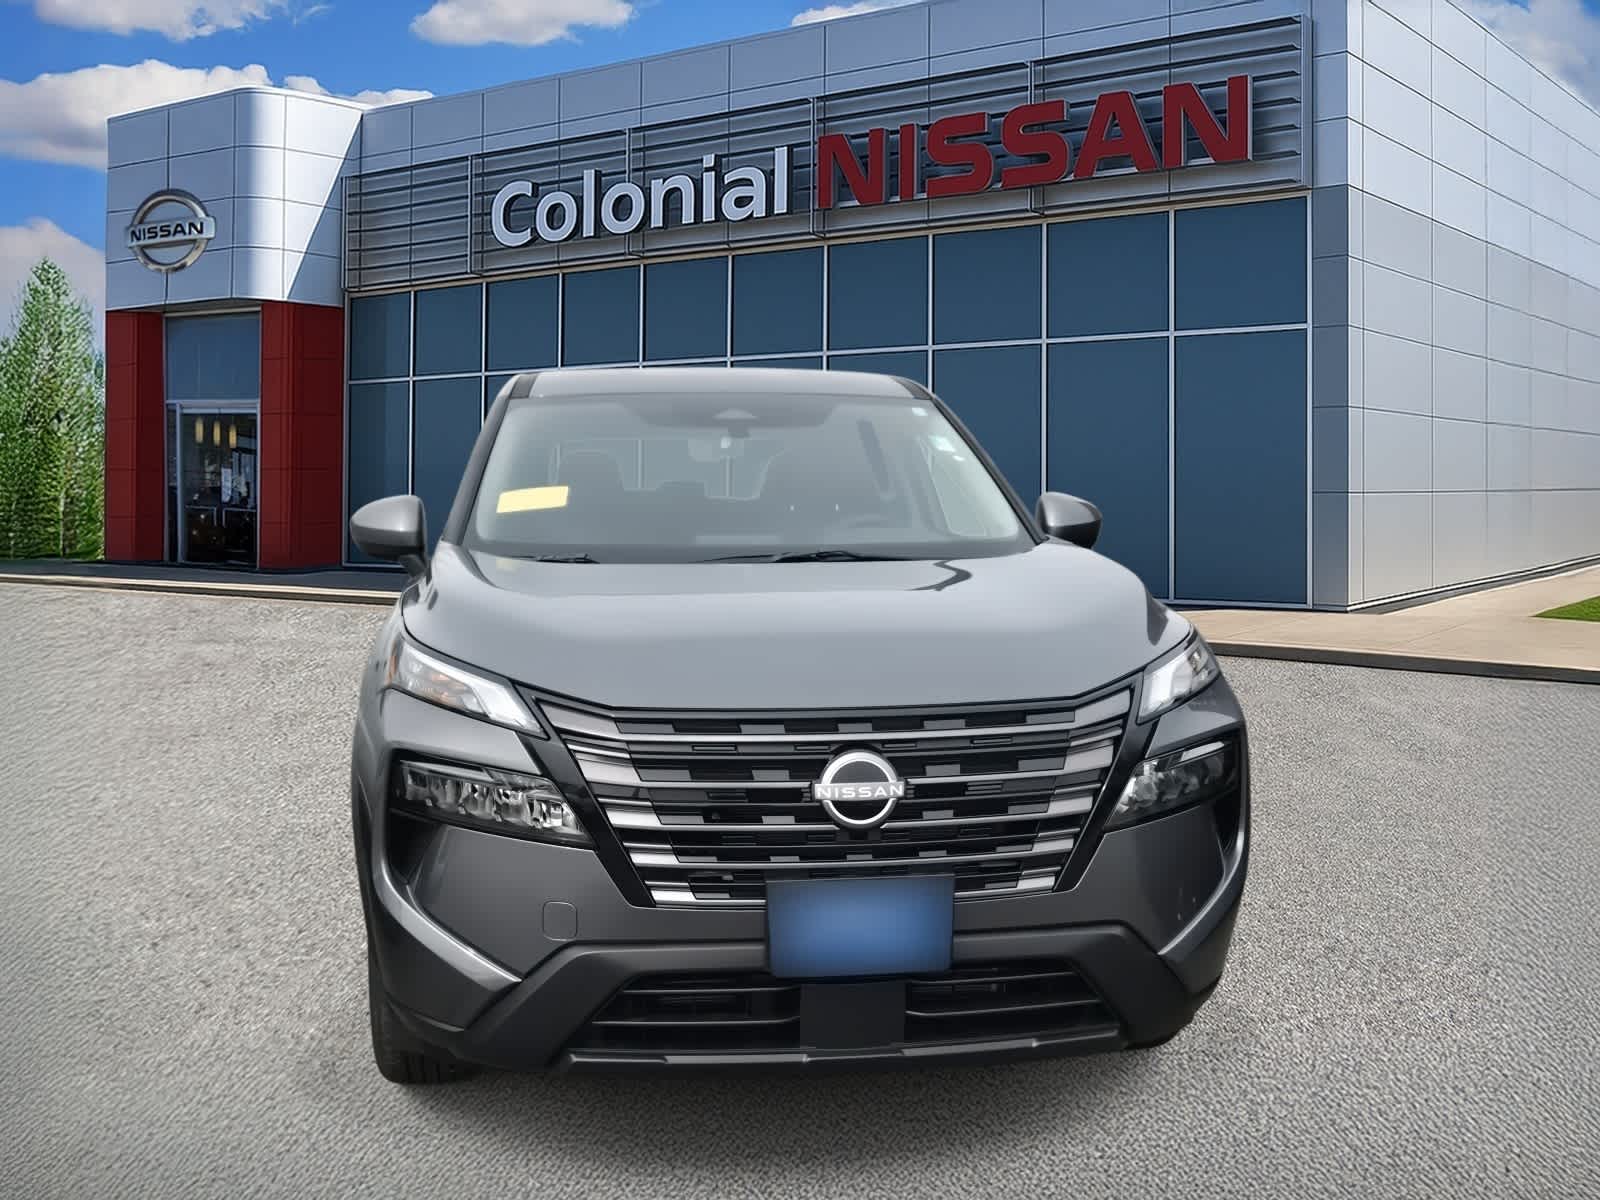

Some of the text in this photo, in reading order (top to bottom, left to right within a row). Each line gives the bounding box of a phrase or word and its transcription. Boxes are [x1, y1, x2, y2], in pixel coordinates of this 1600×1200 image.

[490, 74, 1254, 248] Colonial NISSAN
[130, 221, 204, 242] NISSAN
[817, 784, 903, 798] NISSAN
